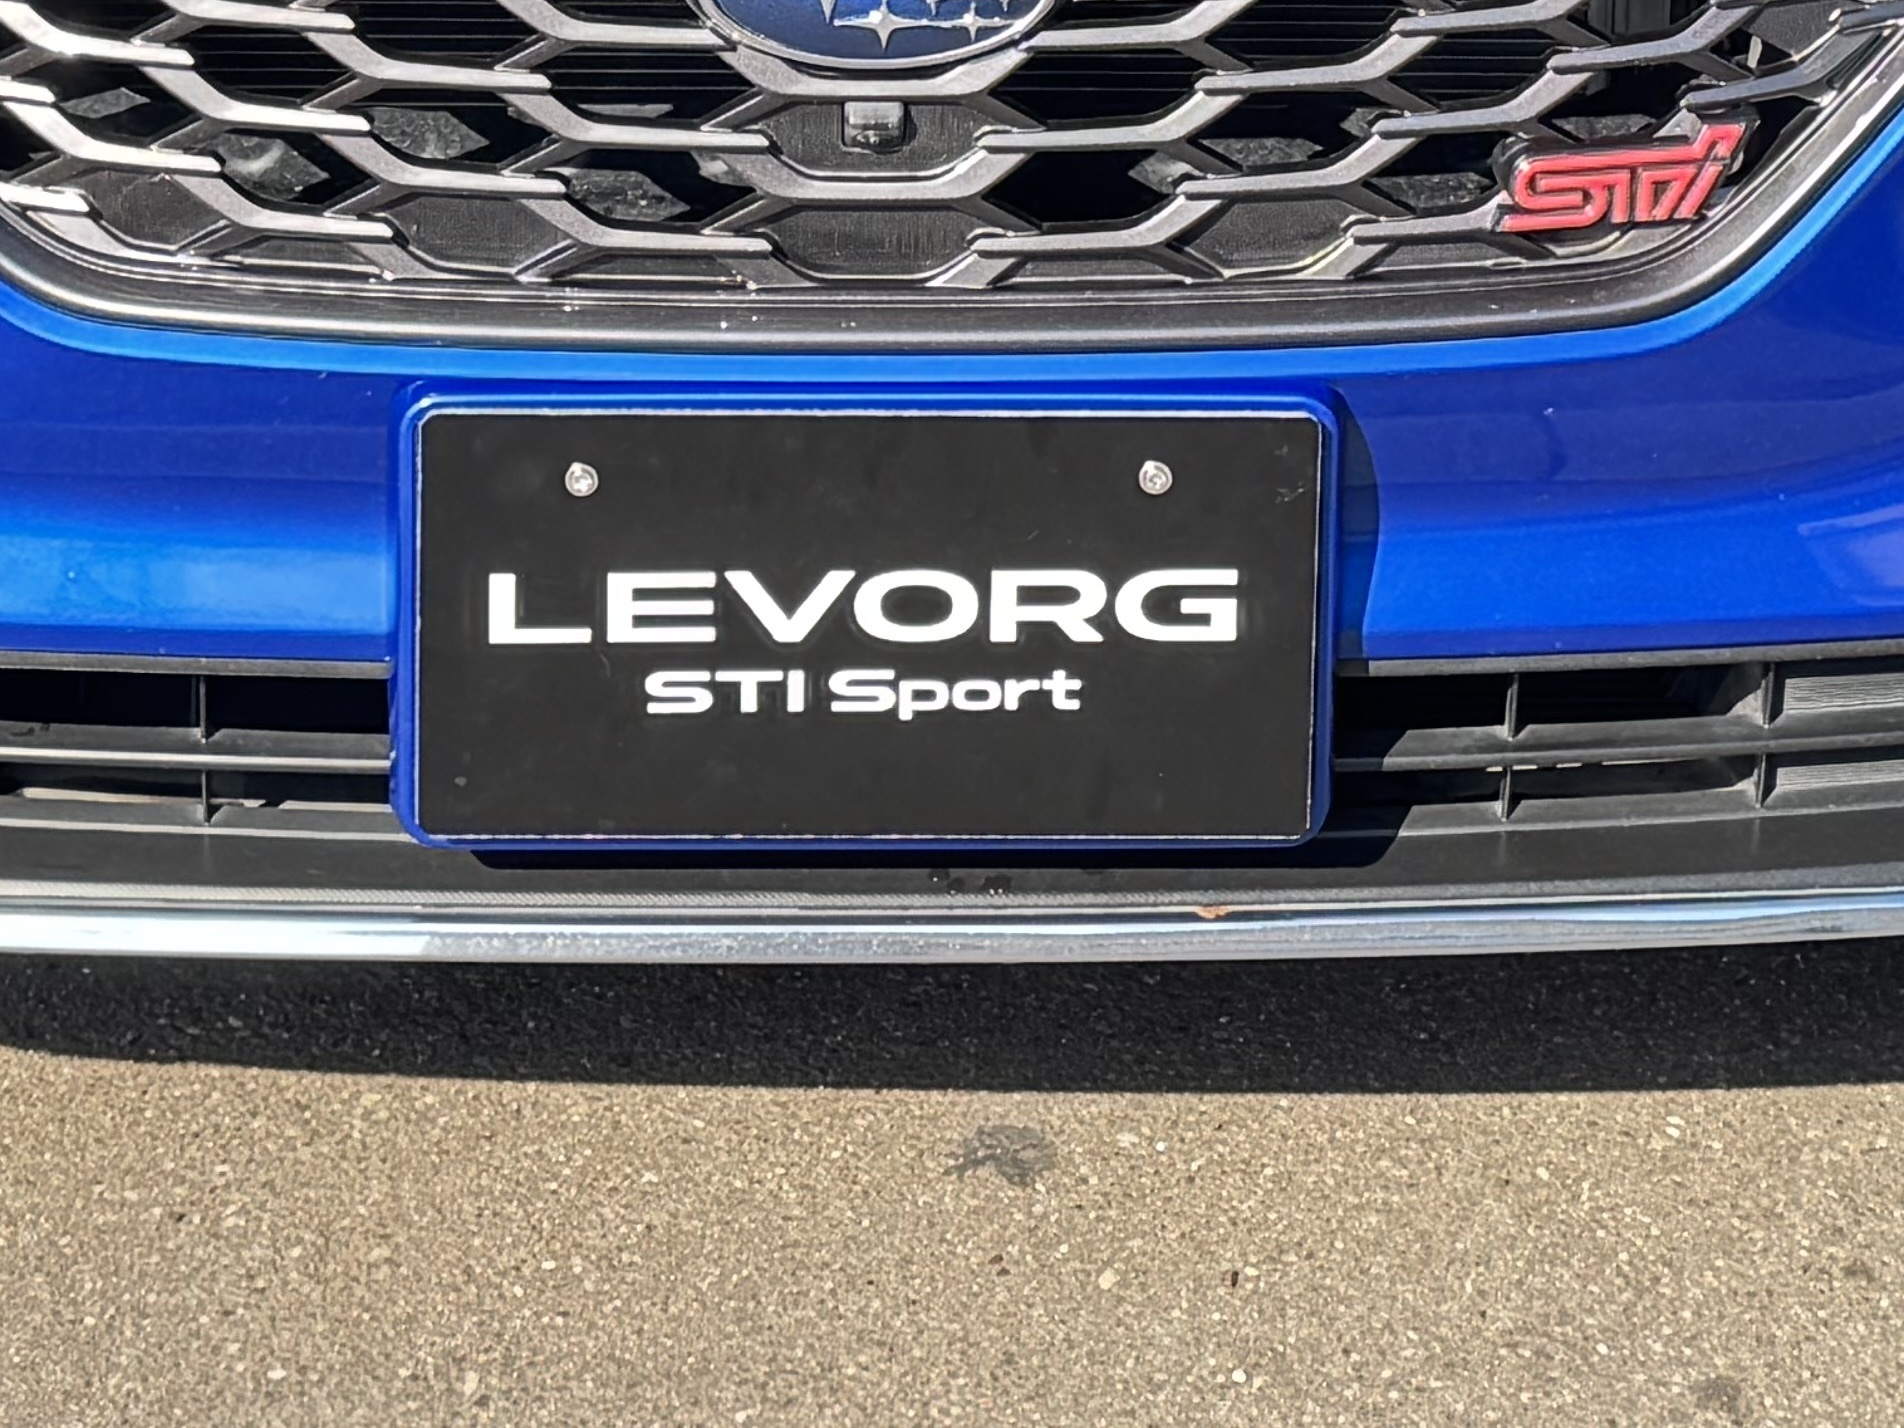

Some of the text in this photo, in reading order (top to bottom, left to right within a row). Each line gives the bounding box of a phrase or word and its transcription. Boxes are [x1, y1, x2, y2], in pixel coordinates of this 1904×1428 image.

[488, 568, 1239, 645] LEVORG
[644, 669, 1083, 721] STI Sport
